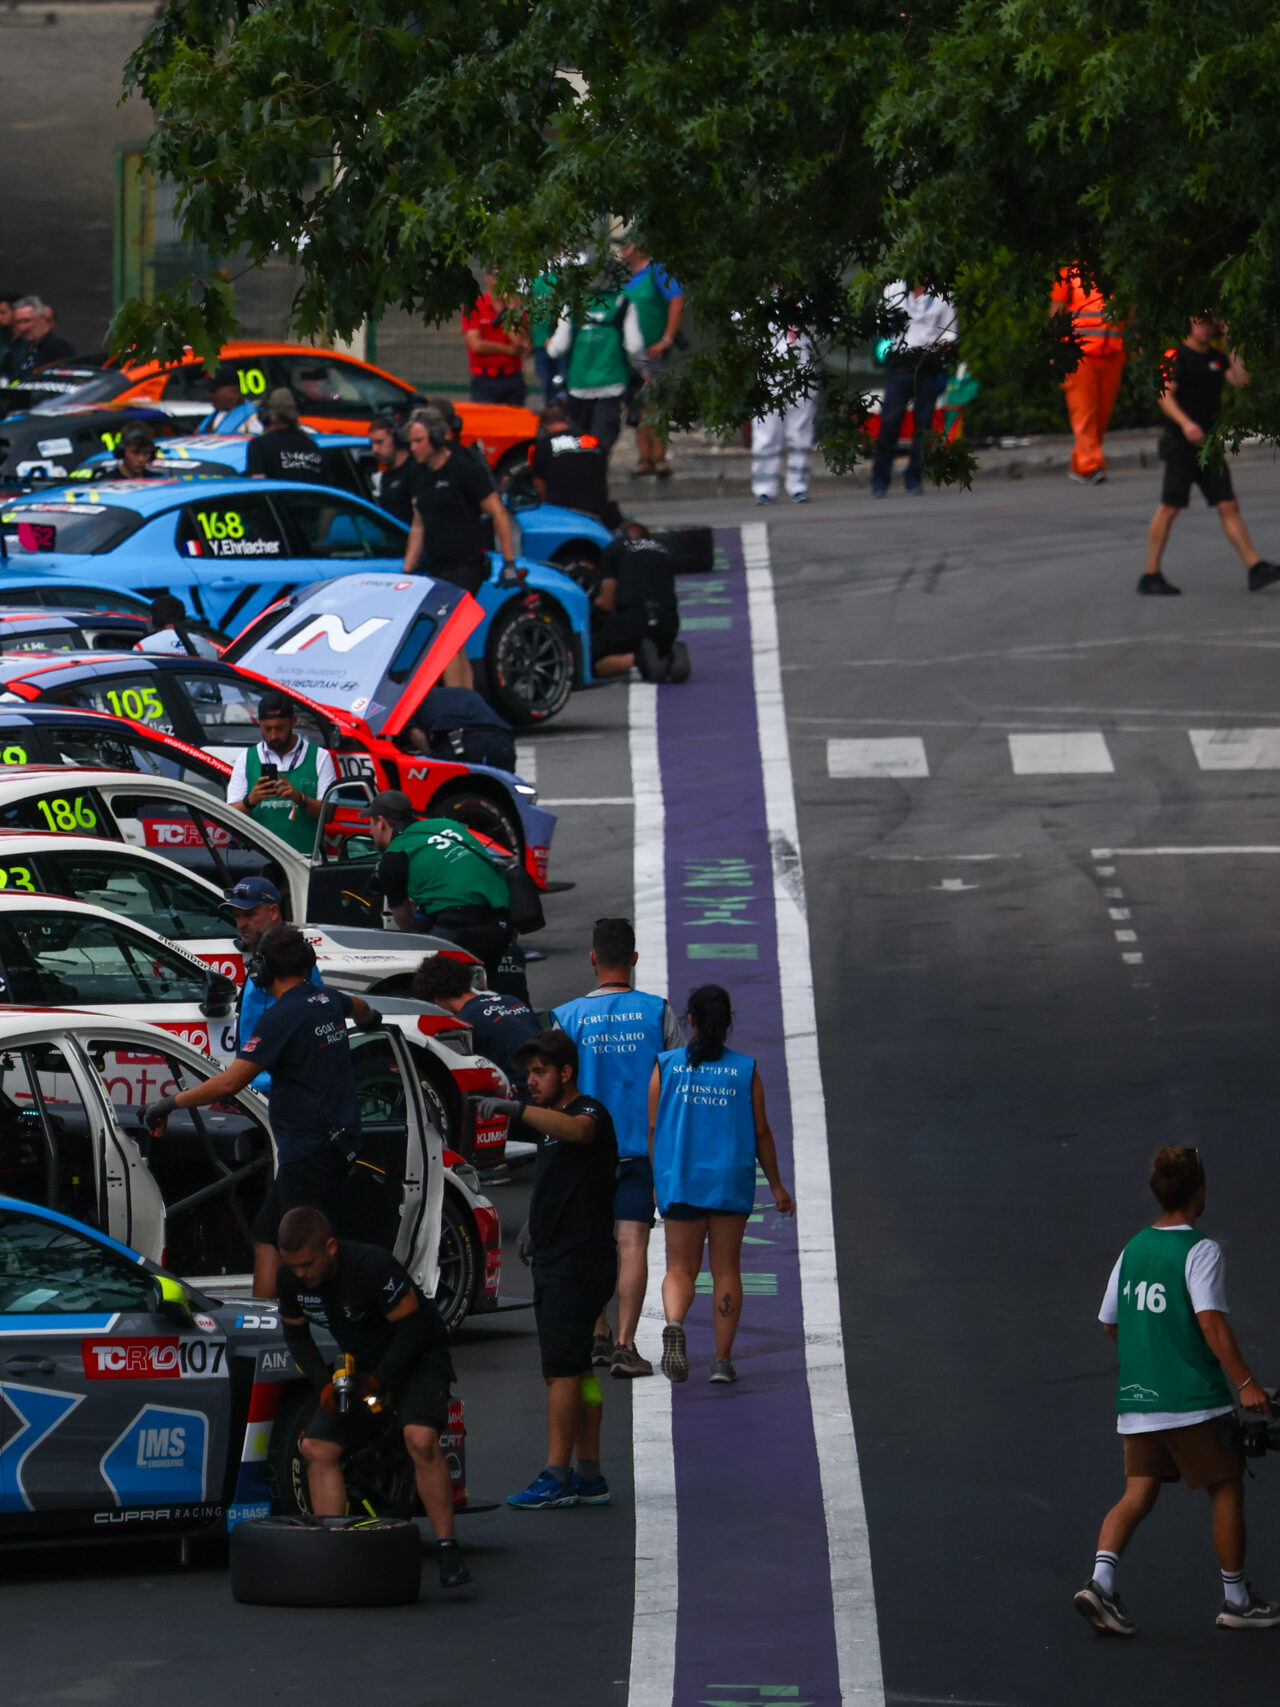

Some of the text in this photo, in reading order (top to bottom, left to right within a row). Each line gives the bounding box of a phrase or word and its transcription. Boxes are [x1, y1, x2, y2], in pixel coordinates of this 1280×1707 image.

[237, 368, 267, 395] 10
[197, 511, 245, 540] 168
[209, 539, 281, 556] Y.Ehrlacher
[106, 687, 164, 720] 105
[164, 736, 233, 776] motorsport.hyun
[37, 797, 97, 832] 186
[577, 1012, 643, 1026] SCRUTINEER
[221, 1026, 236, 1053] 6
[178, 1340, 226, 1374] 107
[94, 1506, 222, 1524] CUPRA RACING
[242, 1507, 268, 1519] BASF
